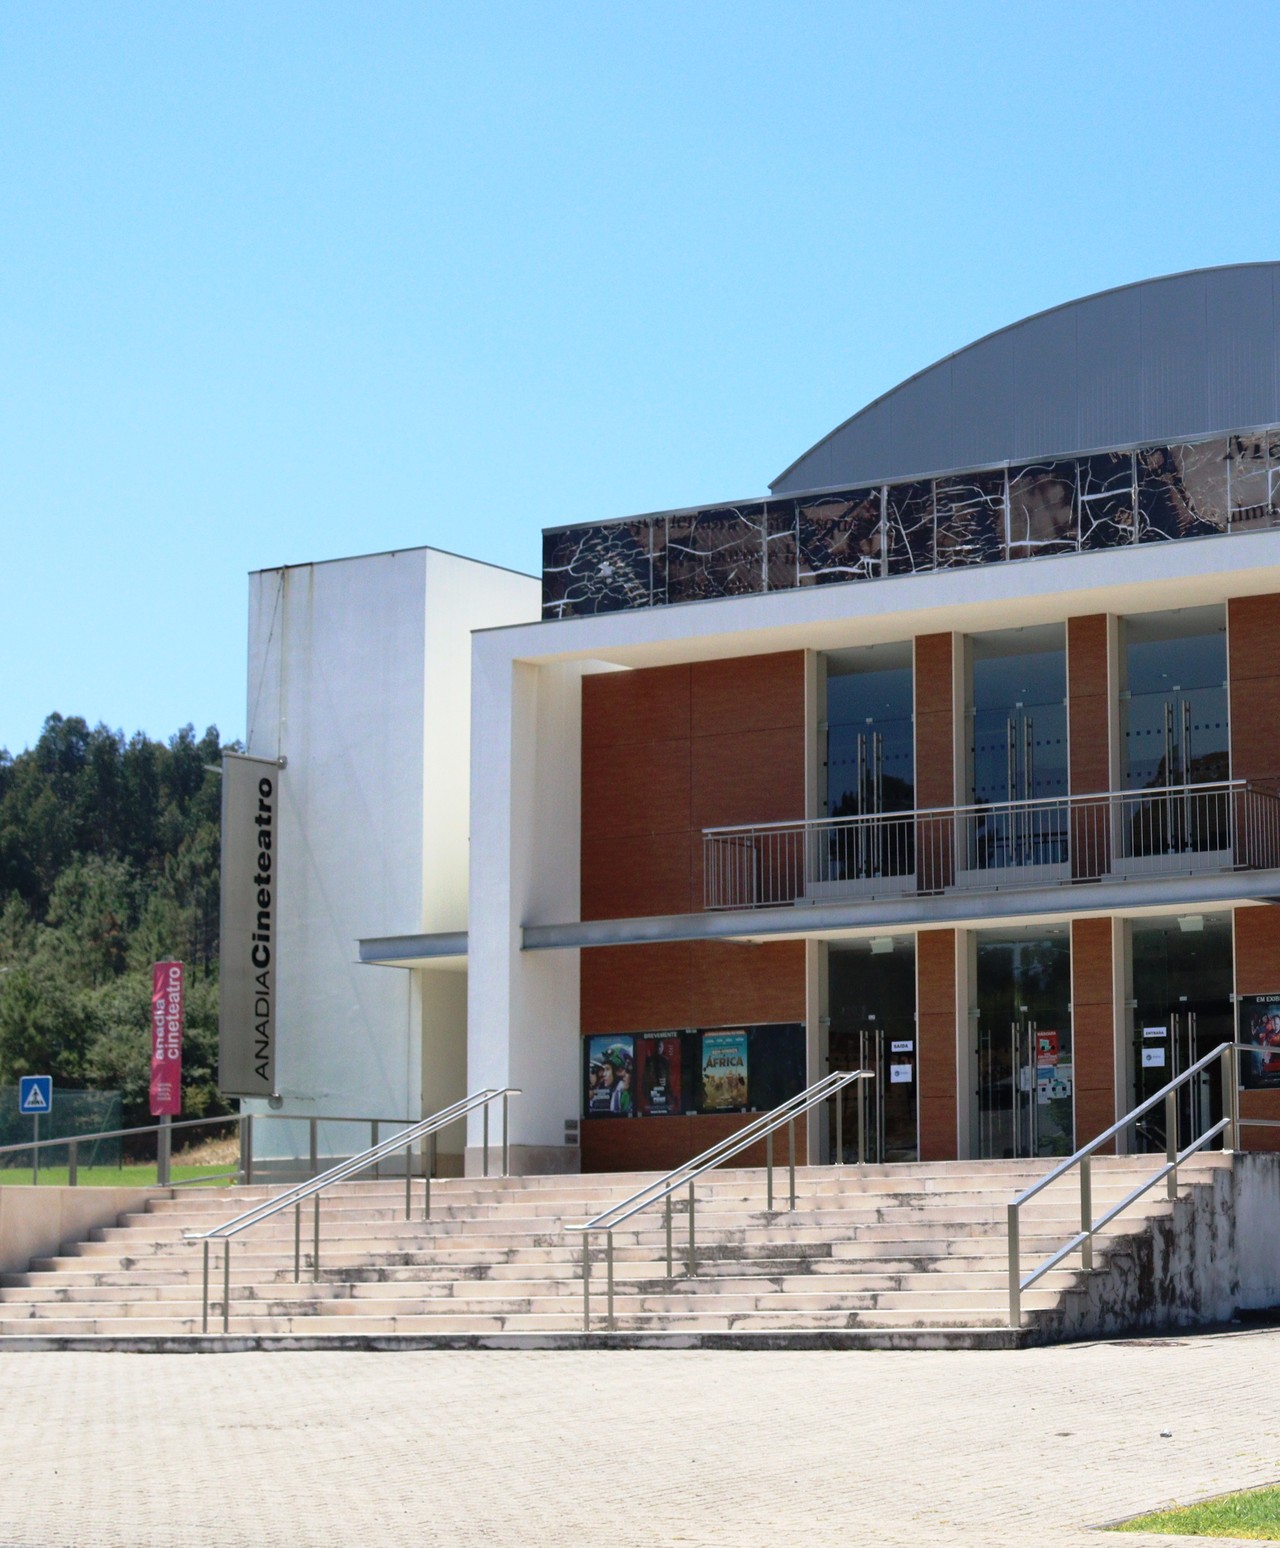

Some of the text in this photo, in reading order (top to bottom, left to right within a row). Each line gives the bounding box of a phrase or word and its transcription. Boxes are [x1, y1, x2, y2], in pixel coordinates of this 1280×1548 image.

[154, 998, 165, 1060] anadia
[165, 967, 181, 1059] cineteatro
[643, 1031, 678, 1040] BREVEMENTE
